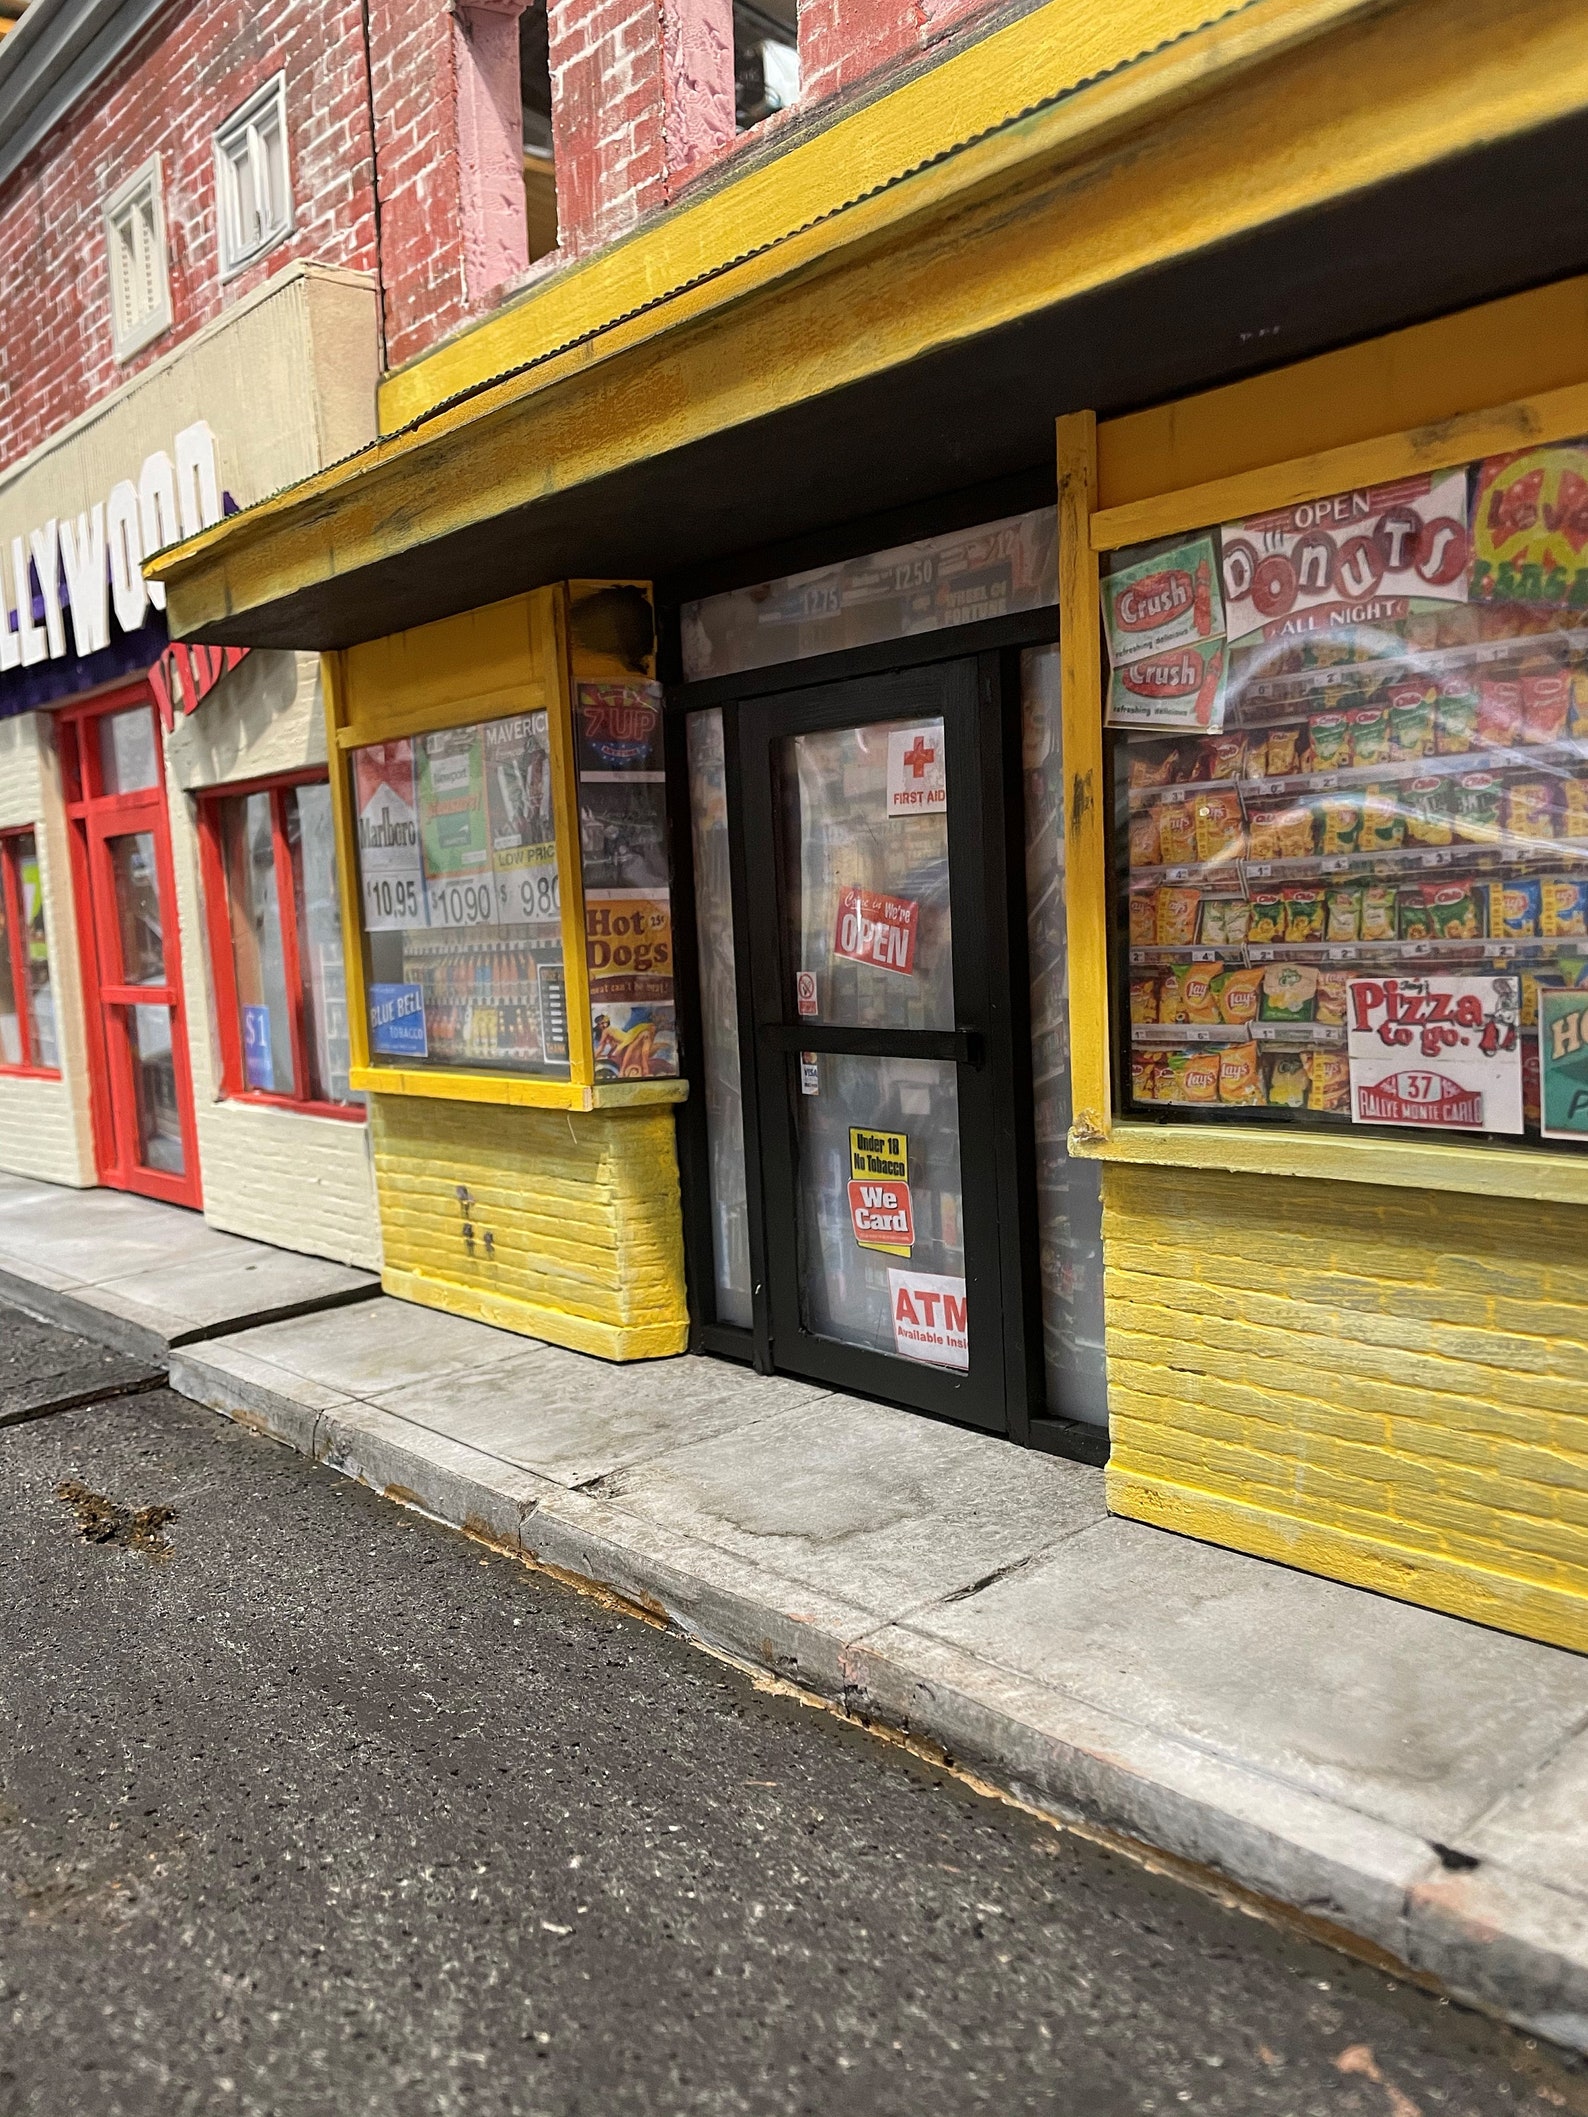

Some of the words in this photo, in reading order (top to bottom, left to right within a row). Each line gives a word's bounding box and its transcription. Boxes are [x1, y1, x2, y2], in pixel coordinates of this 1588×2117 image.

[1294, 490, 1371, 528] OPEN
[1120, 576, 1188, 624] Crush
[1279, 616, 1321, 637] ALL
[1330, 601, 1396, 627] NIGHT
[1115, 639, 1154, 659] refreshing
[1129, 656, 1196, 686] Crush
[893, 790, 923, 805] FIRST
[927, 789, 946, 803] AID
[359, 807, 416, 853] Marlboro
[499, 851, 524, 867] LOW
[528, 845, 556, 862] PRIC
[845, 891, 868, 907] Coe
[885, 902, 911, 923] We're
[587, 909, 645, 937] Hot
[841, 913, 910, 967] OPEN
[587, 939, 669, 972] Dogs
[371, 1001, 394, 1028] BLUE
[397, 990, 422, 1018] BELL
[1350, 979, 1484, 1032] Pizza
[1378, 1020, 1414, 1046] to
[1408, 1075, 1432, 1099] 37
[1402, 1102, 1440, 1120] MONTE
[857, 1133, 885, 1154] Under
[888, 1138, 899, 1156] 18
[854, 1152, 866, 1171] No
[867, 1155, 905, 1177] Tobacco
[860, 1186, 898, 1209] We
[855, 1207, 909, 1233] Card
[896, 1287, 967, 1332] ATM
[898, 1326, 943, 1345] Available
[947, 1335, 968, 1350] Insi
